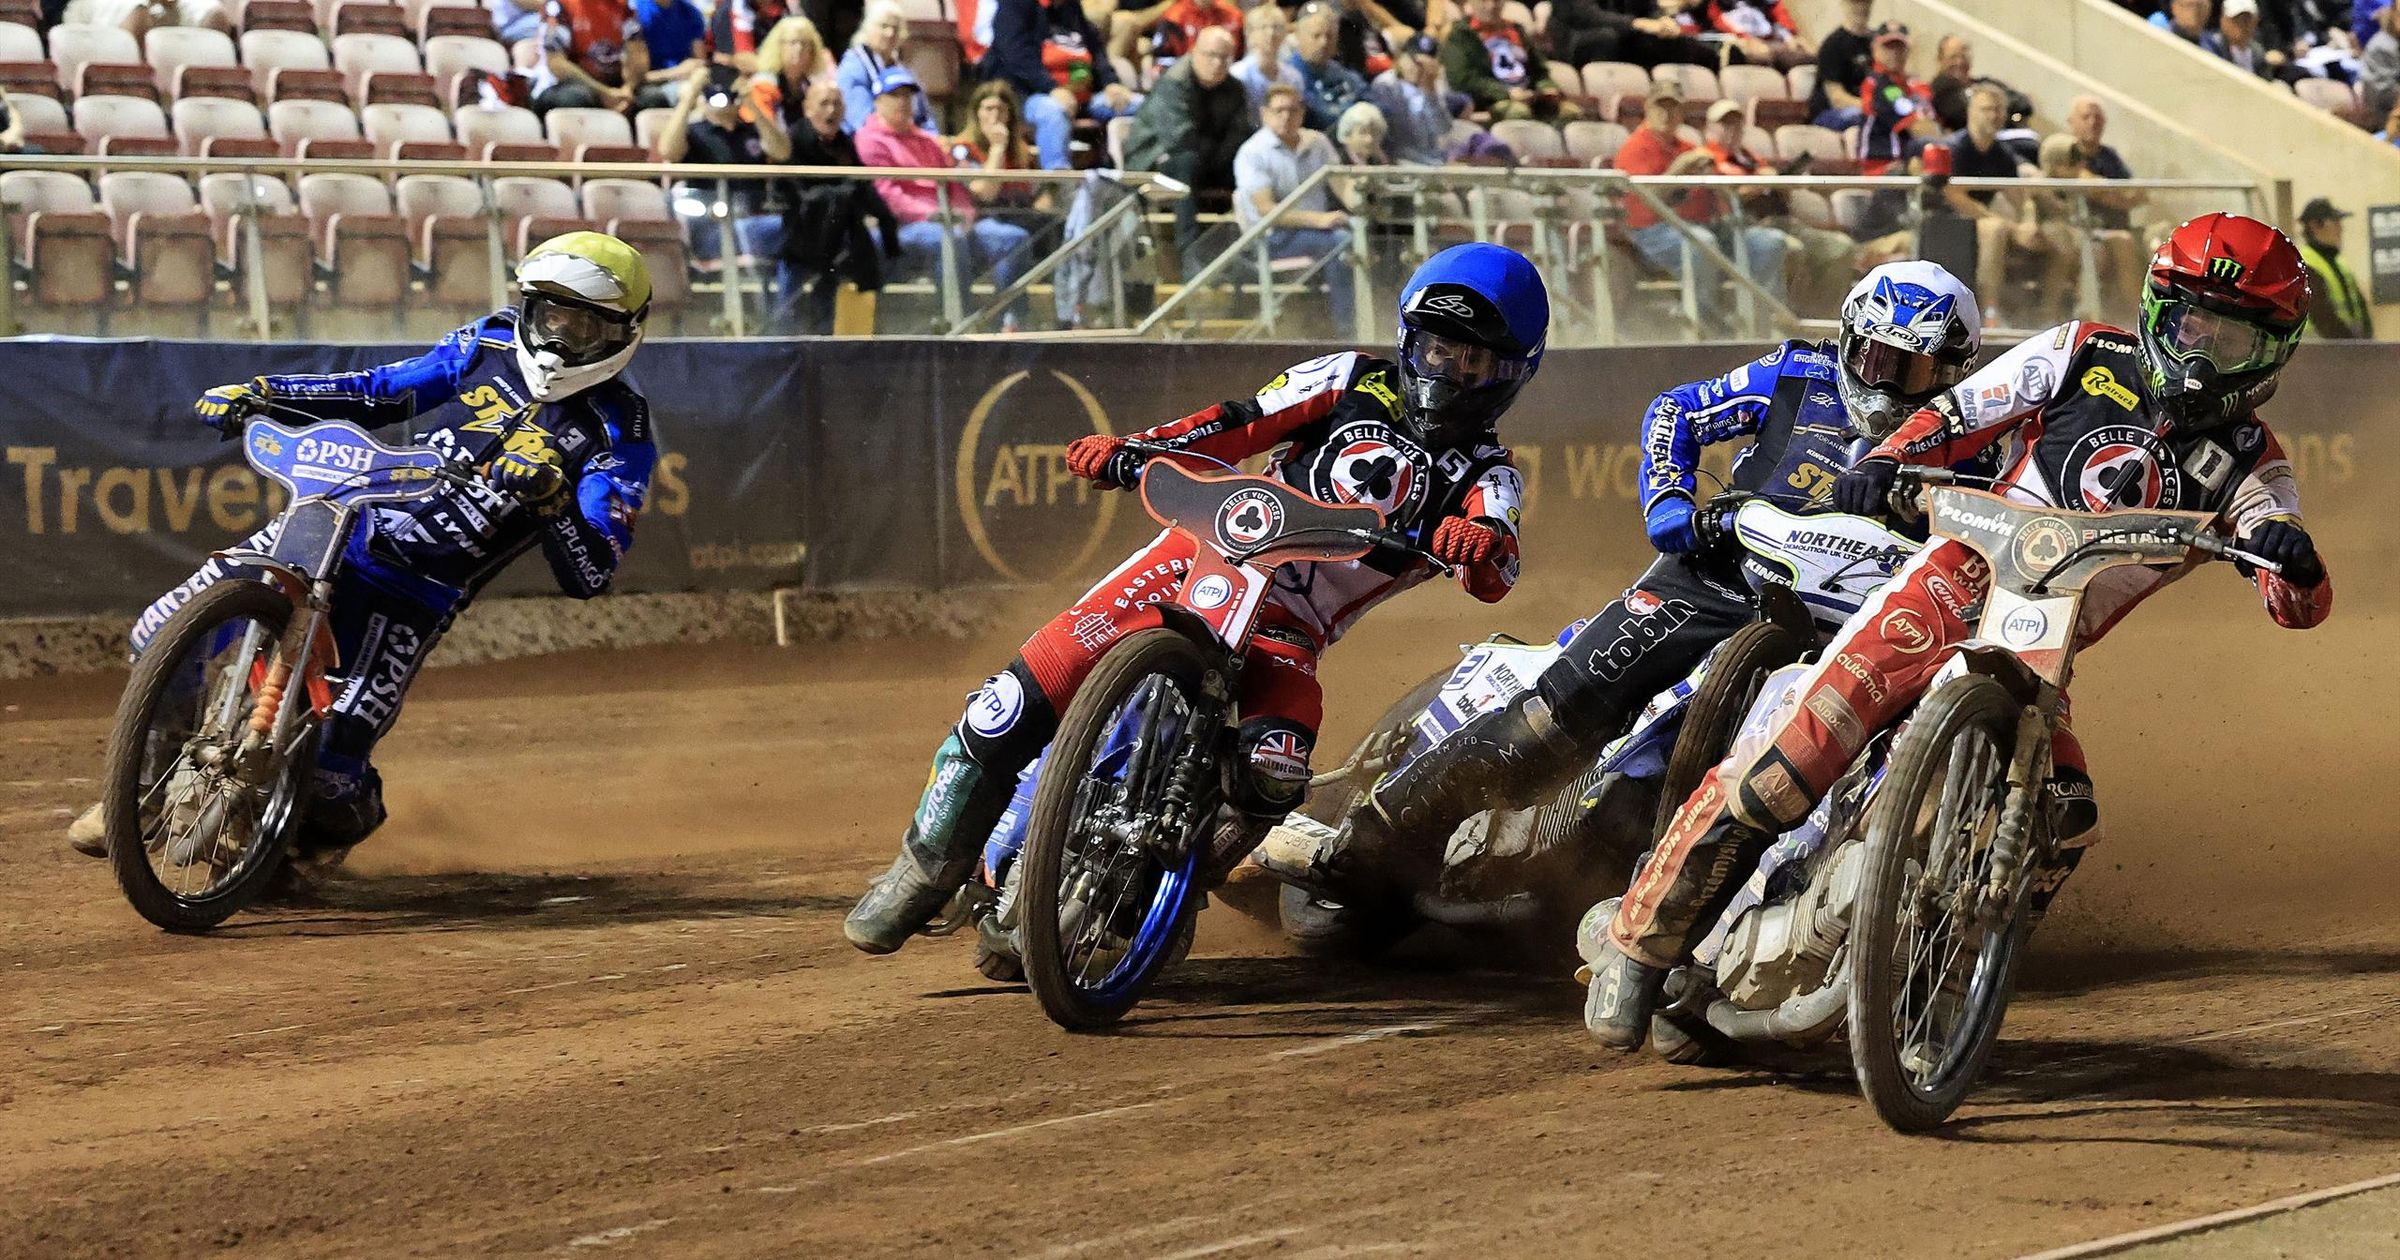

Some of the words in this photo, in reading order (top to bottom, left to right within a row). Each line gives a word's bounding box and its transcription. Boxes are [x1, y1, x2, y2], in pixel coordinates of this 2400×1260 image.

[1882, 326, 1918, 342] Arai
[2088, 370, 2135, 408] Rentruck
[316, 440, 377, 472] PSH
[1342, 426, 1390, 443] BELLE
[1411, 464, 1427, 502] ACES
[2088, 430, 2135, 450] BELLE
[2161, 467, 2174, 507] ACES
[1224, 491, 1250, 512] BELLE
[1251, 491, 1269, 501] VUE
[1267, 500, 1282, 521] ACES
[1783, 543, 1829, 555] DEMOLITION
[1829, 550, 1841, 559] UK
[1842, 552, 1858, 562] LTD
[1114, 557, 1194, 609] EASTERN
[1134, 581, 1183, 612] POIN
[1198, 585, 1223, 599] ATPI
[131, 556, 224, 650] HANSEN
[1890, 617, 1925, 646] ATPI
[2007, 617, 2040, 633] ATPI
[351, 649, 412, 730] PSH
